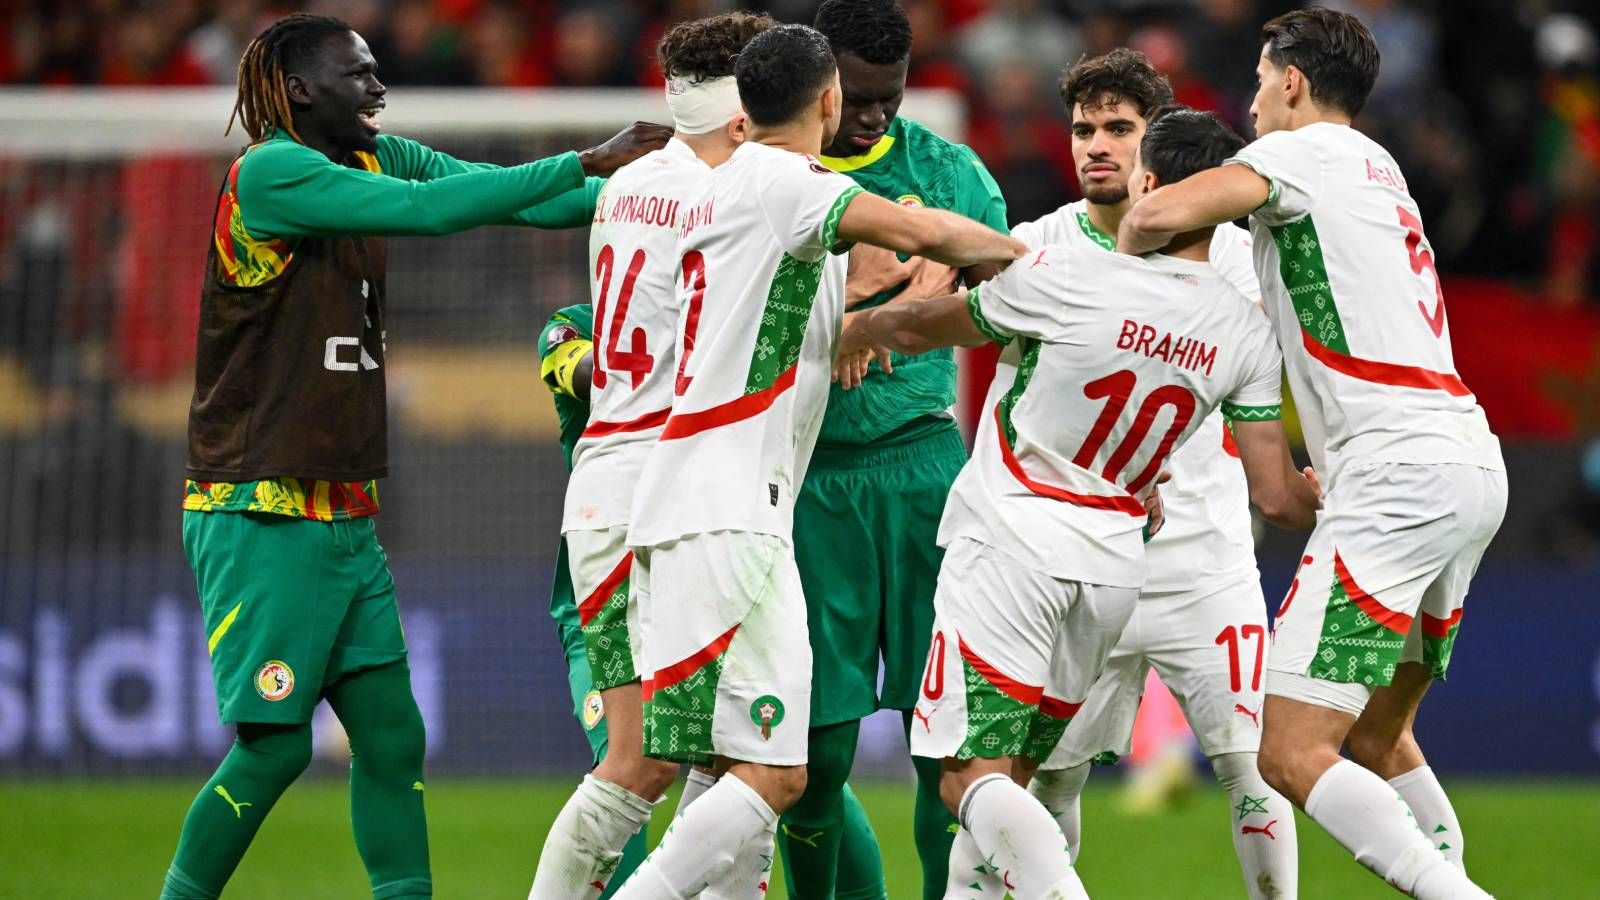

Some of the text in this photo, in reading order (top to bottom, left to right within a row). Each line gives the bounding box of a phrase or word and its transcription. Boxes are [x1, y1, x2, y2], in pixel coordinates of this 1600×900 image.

[592, 243, 655, 391] 14
[1396, 205, 1444, 338] 5
[1116, 319, 1218, 376] BRAHIM
[1069, 369, 1197, 496] 10
[1214, 624, 1265, 693] 17
